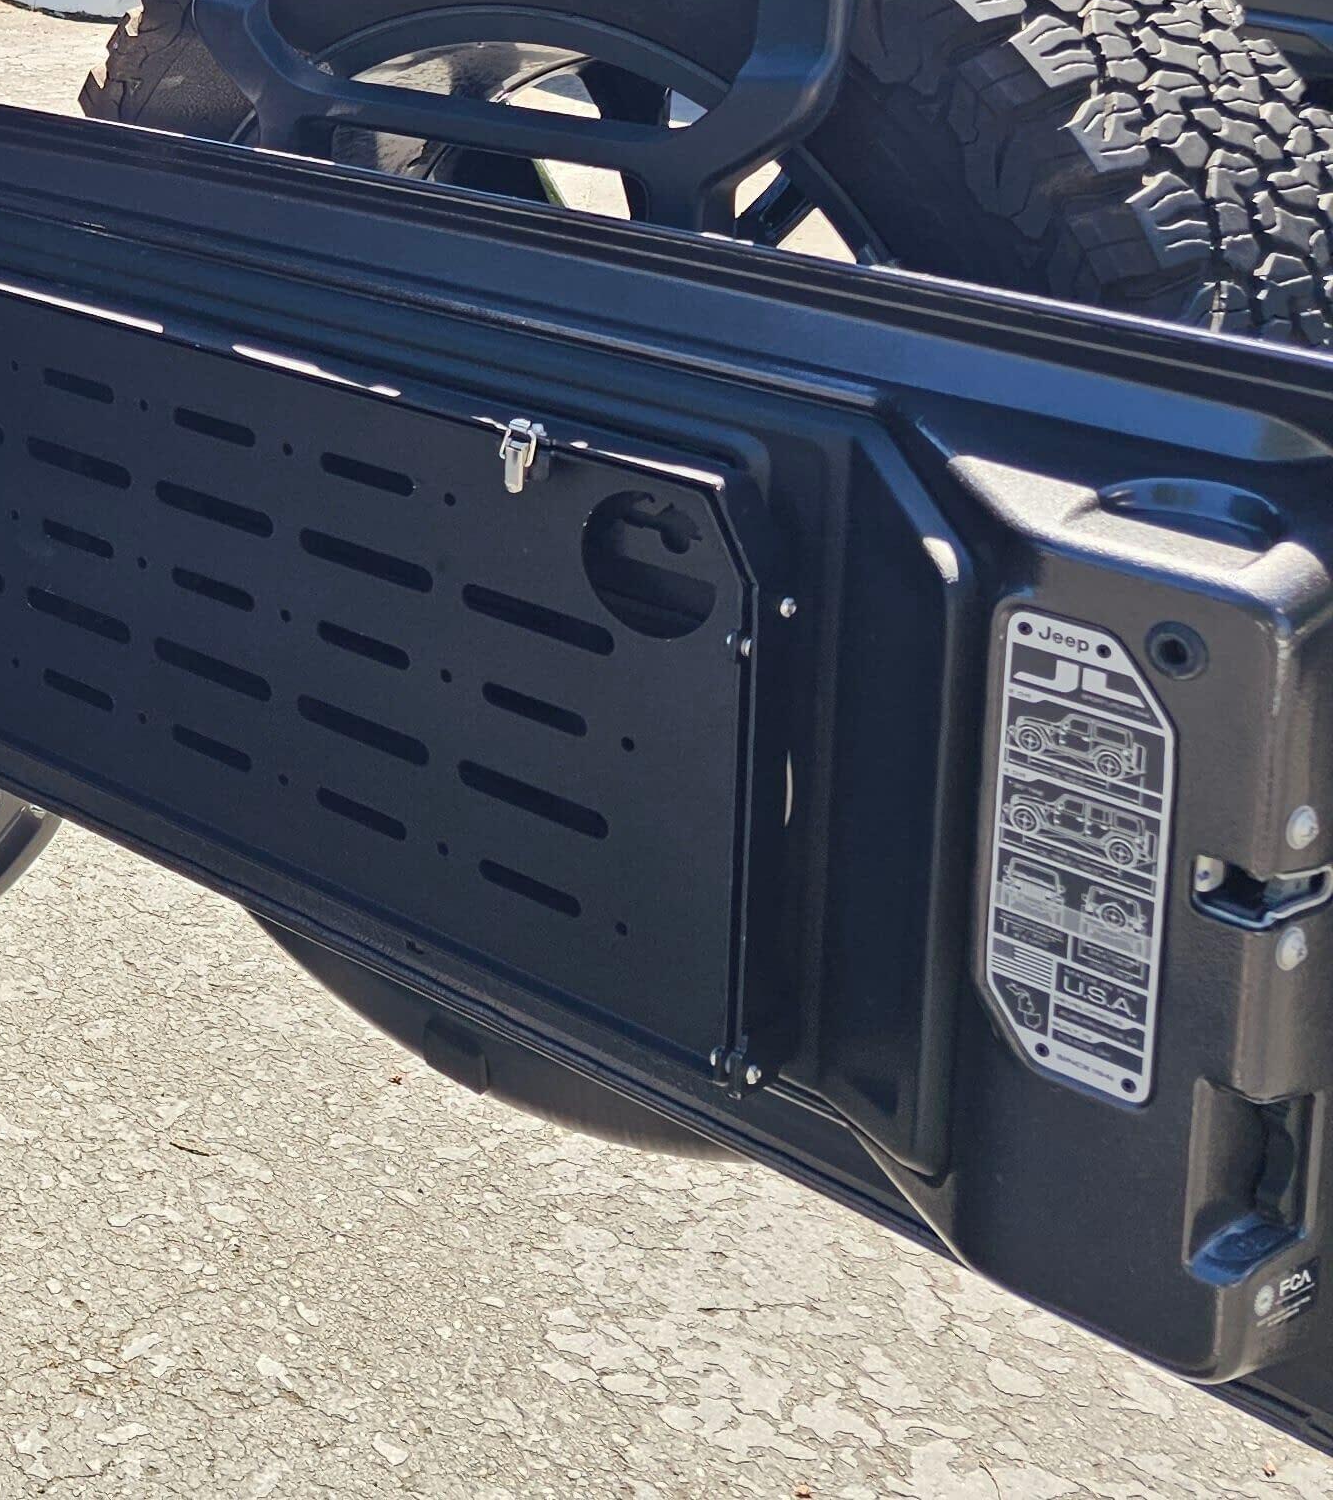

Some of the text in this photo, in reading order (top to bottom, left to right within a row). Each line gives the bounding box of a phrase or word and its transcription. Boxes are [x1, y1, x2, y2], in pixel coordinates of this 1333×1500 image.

[1038, 626, 1090, 653] Jeep
[1013, 660, 1145, 709] JL
[1063, 975, 1137, 1019] U.S.A.
[1279, 1269, 1312, 1297] FCA
